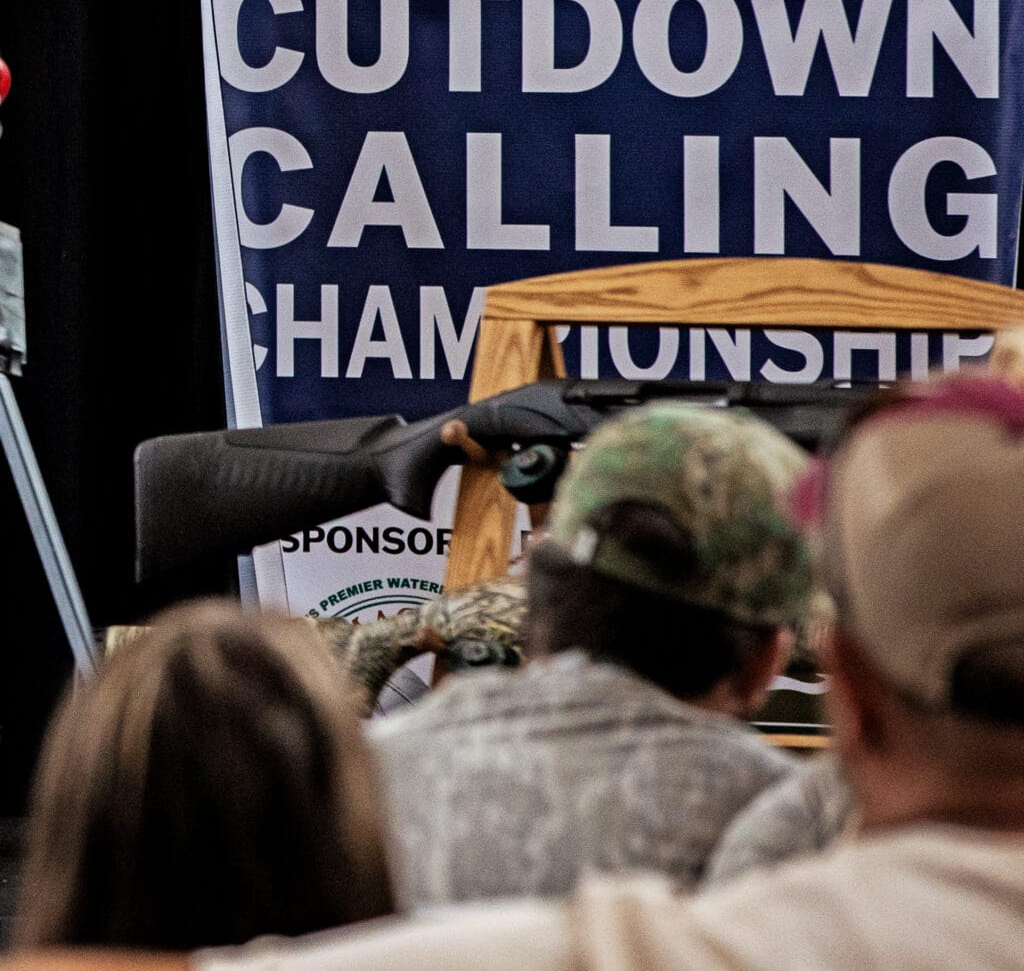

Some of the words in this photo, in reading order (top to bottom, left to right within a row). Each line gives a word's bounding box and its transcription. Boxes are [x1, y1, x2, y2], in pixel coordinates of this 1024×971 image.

[228, 126, 999, 260] CALLING
[245, 282, 995, 385] HAMIONSHIP
[319, 579, 383, 612] PREMIER
[387, 577, 444, 595] WATER
